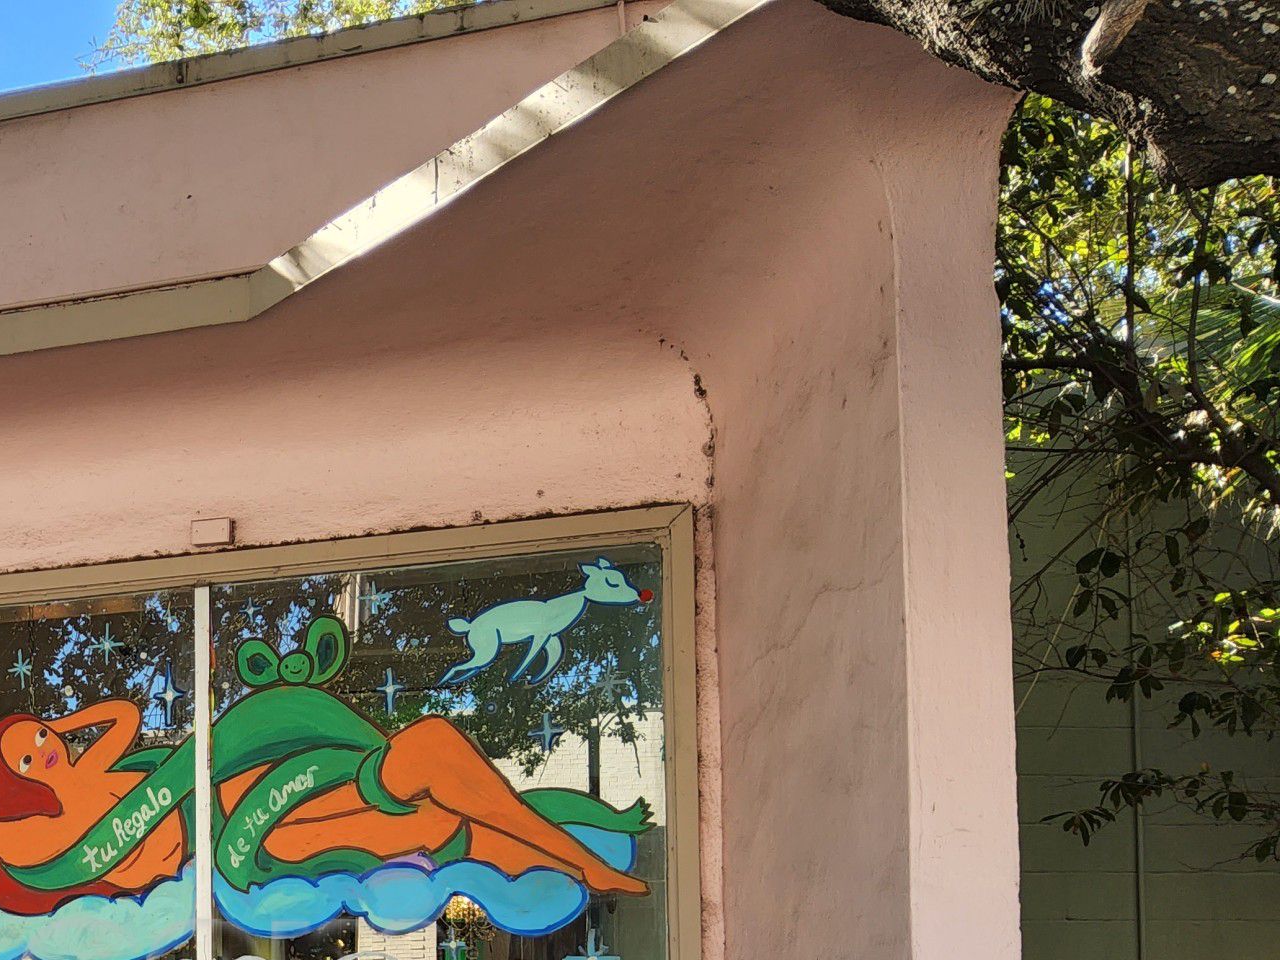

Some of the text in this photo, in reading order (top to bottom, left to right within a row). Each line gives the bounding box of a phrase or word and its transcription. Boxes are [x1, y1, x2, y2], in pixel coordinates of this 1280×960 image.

[112, 786, 172, 848] Regalo
[228, 837, 251, 869] de
[243, 808, 270, 838] tu
